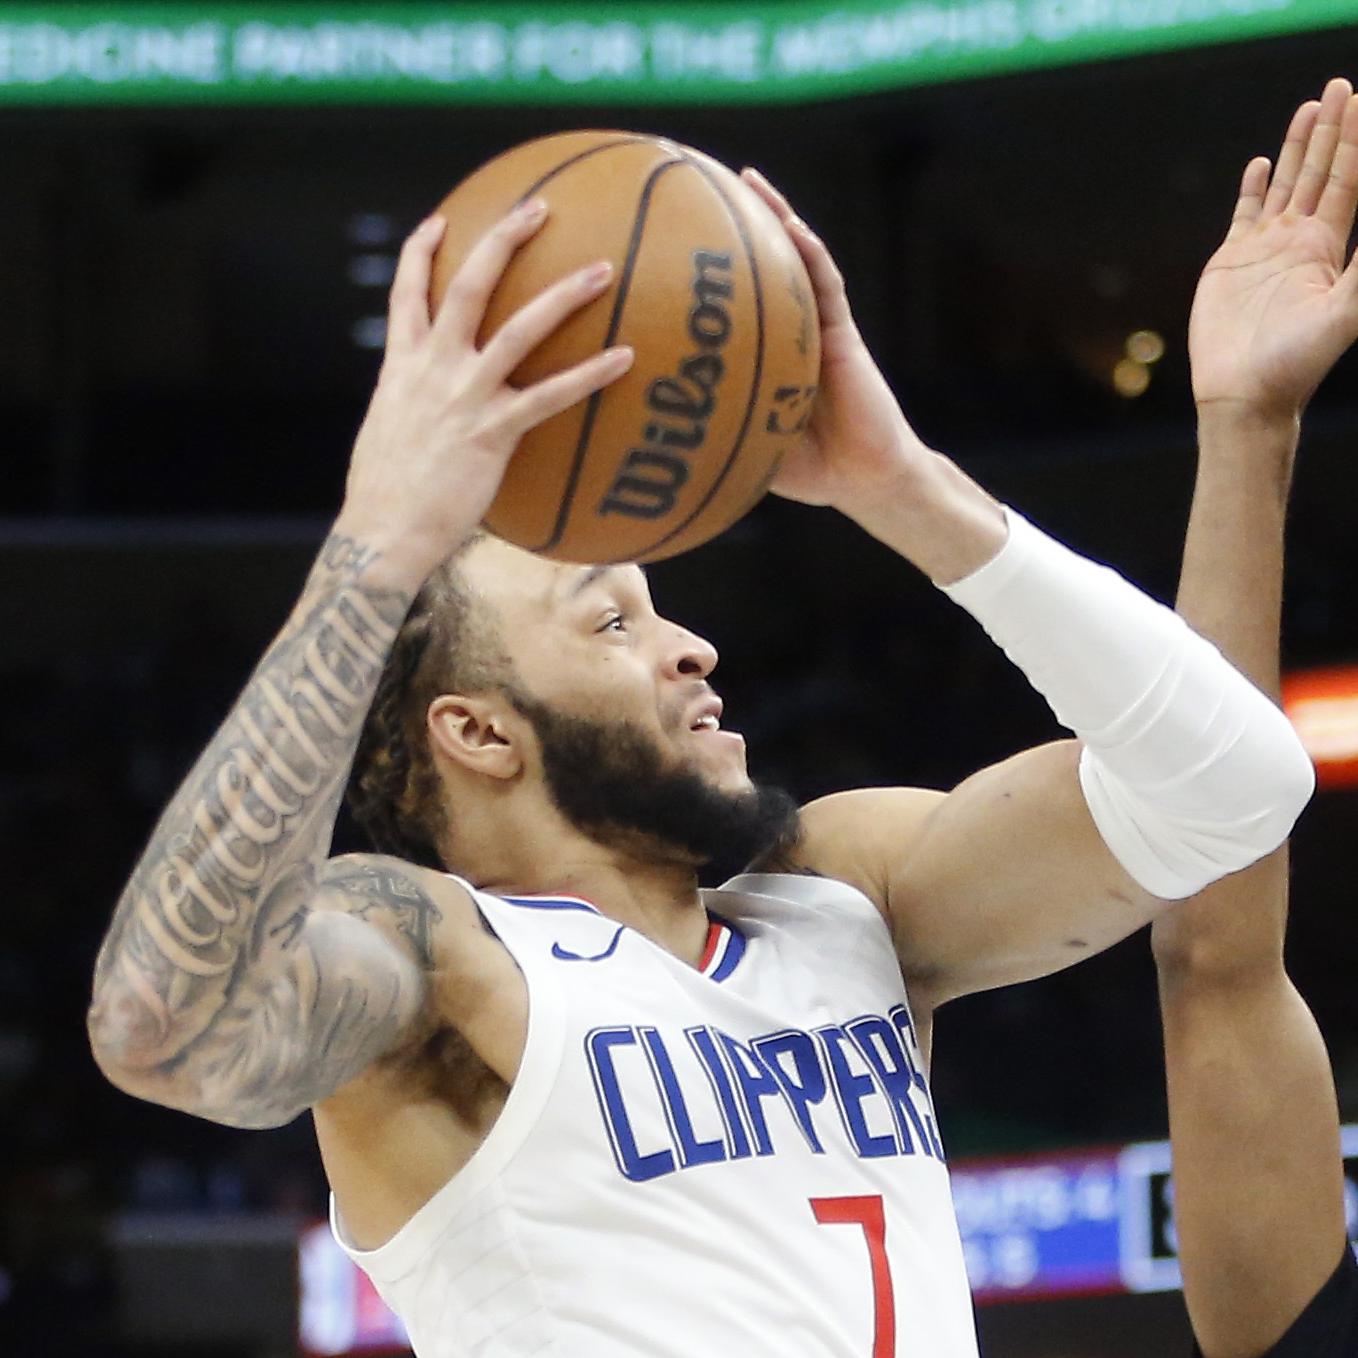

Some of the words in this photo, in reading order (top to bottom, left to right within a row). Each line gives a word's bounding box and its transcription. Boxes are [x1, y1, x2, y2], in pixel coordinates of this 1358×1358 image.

[234, 18, 508, 84] PARTNER
[510, 20, 642, 84] FOR
[648, 20, 762, 82] THE
[598, 249, 734, 519] Wilson
